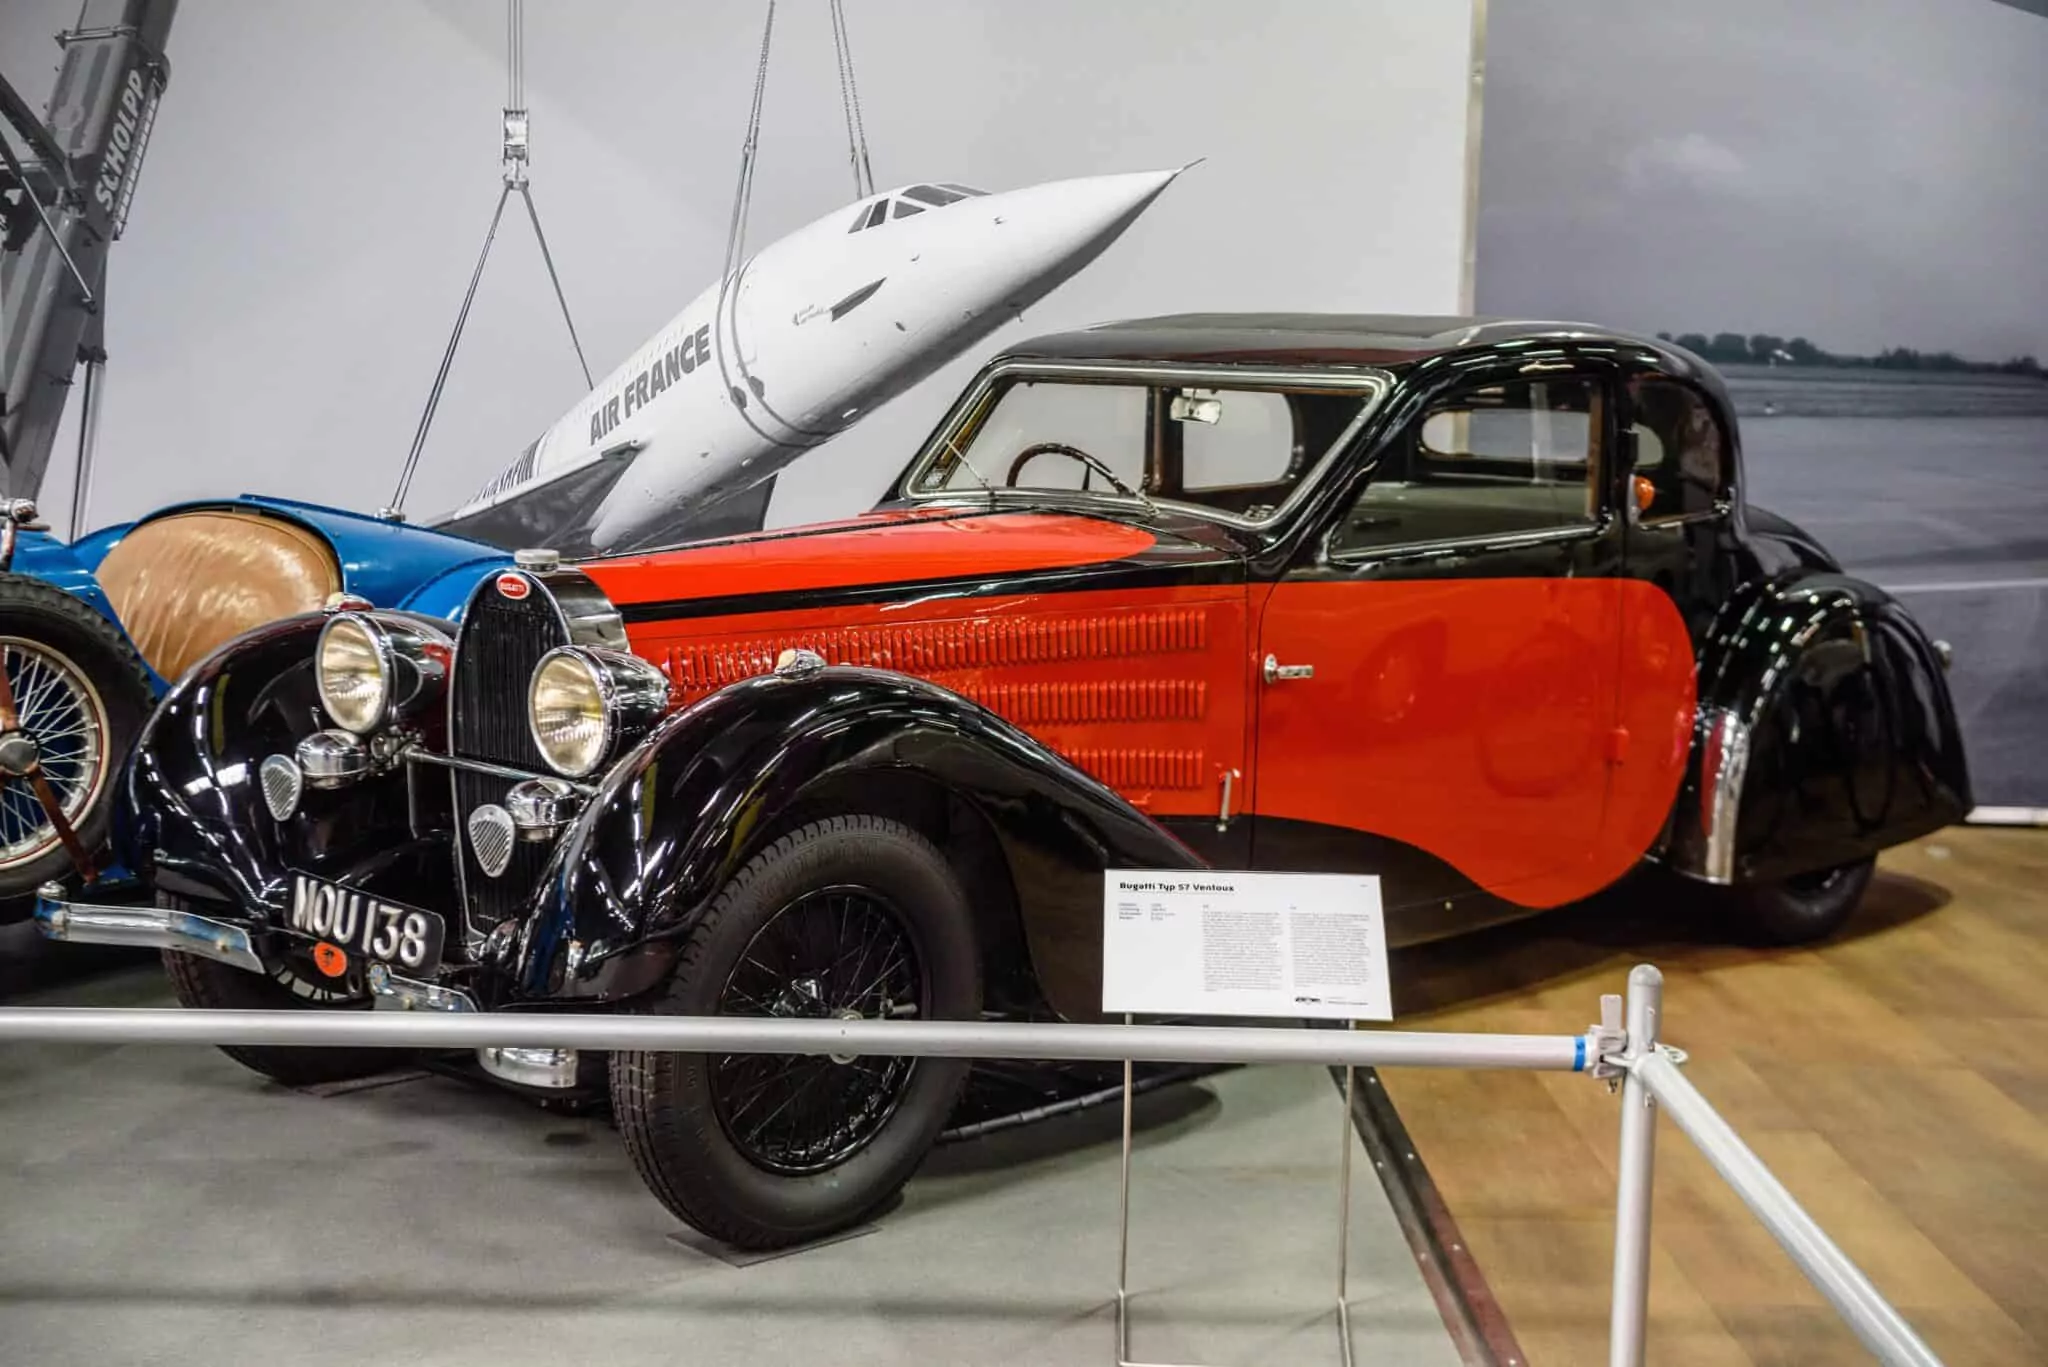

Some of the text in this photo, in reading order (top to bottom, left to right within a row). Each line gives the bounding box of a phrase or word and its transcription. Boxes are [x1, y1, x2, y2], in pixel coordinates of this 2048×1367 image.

[95, 69, 144, 212] SCHOLPP
[590, 323, 711, 446] AIR FRANCE
[362, 900, 427, 967] 138
[1119, 882, 1155, 891] Bugatti
[1158, 883, 1175, 892] Typ
